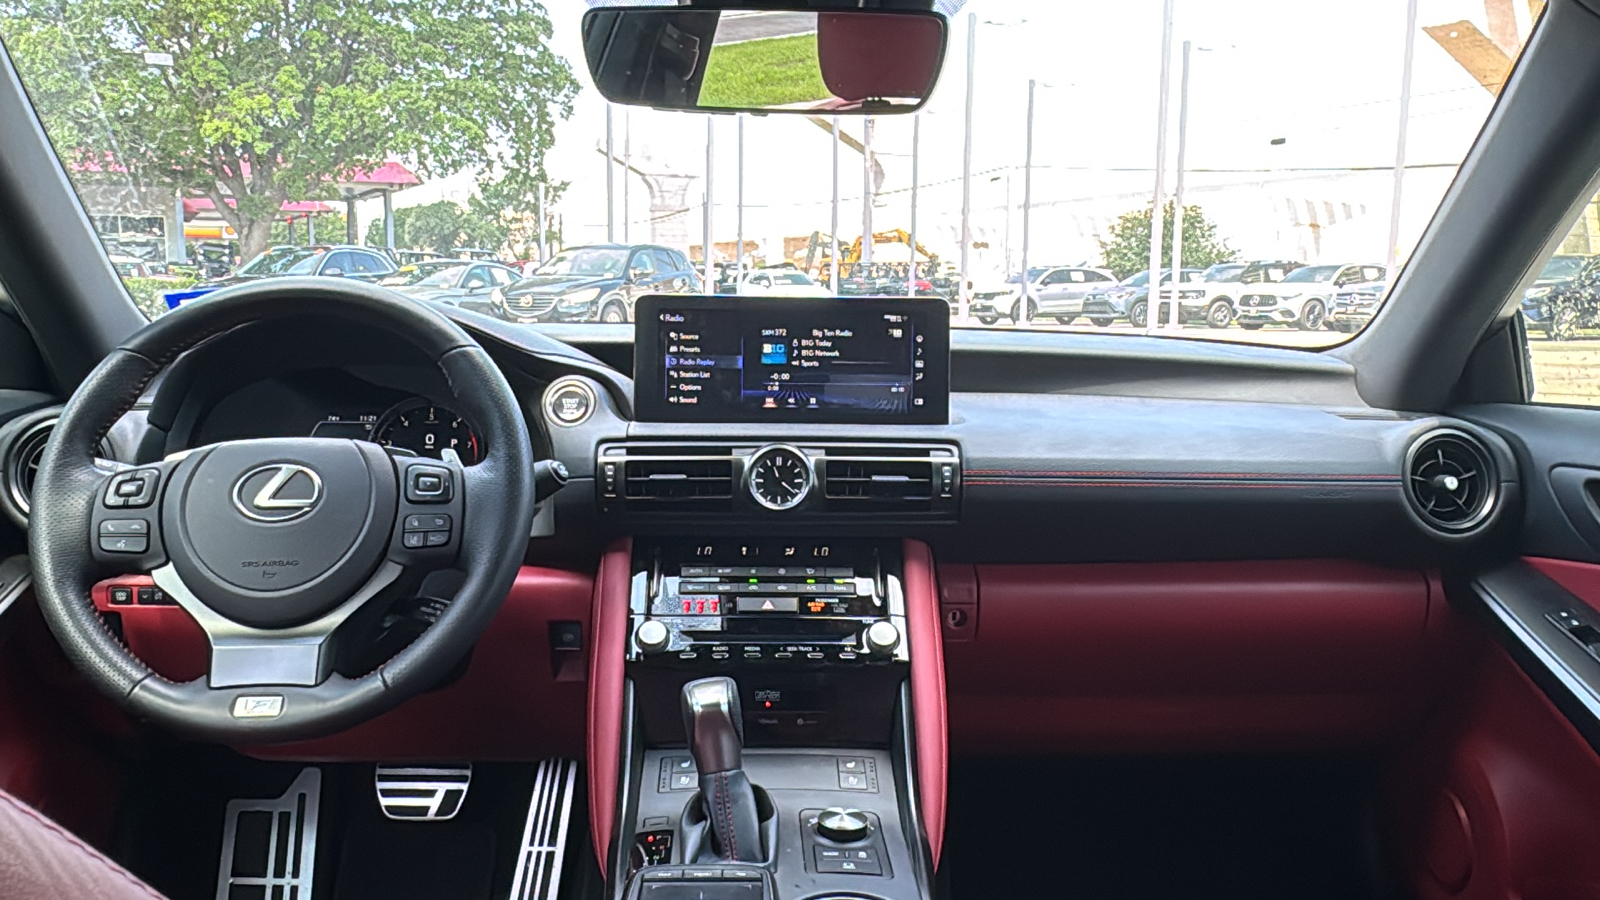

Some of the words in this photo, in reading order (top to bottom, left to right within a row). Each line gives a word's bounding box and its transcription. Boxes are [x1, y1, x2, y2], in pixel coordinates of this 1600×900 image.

[665, 313, 685, 322] Radio
[679, 332, 699, 340] Source
[774, 328, 787, 336] 372
[812, 329, 823, 338] Big
[823, 329, 835, 337] Ten
[835, 329, 853, 337] Radio
[815, 339, 832, 348] Today
[679, 345, 701, 353] Presets
[815, 349, 840, 357] Network
[679, 358, 696, 366] Radio
[696, 358, 716, 367] Replay
[801, 359, 820, 368] Sports
[679, 370, 699, 379] Station
[700, 370, 711, 379] List
[679, 383, 702, 392] Options
[679, 396, 698, 404] Sound
[450, 438, 458, 448] P
[260, 559, 300, 567] AIRBAG
